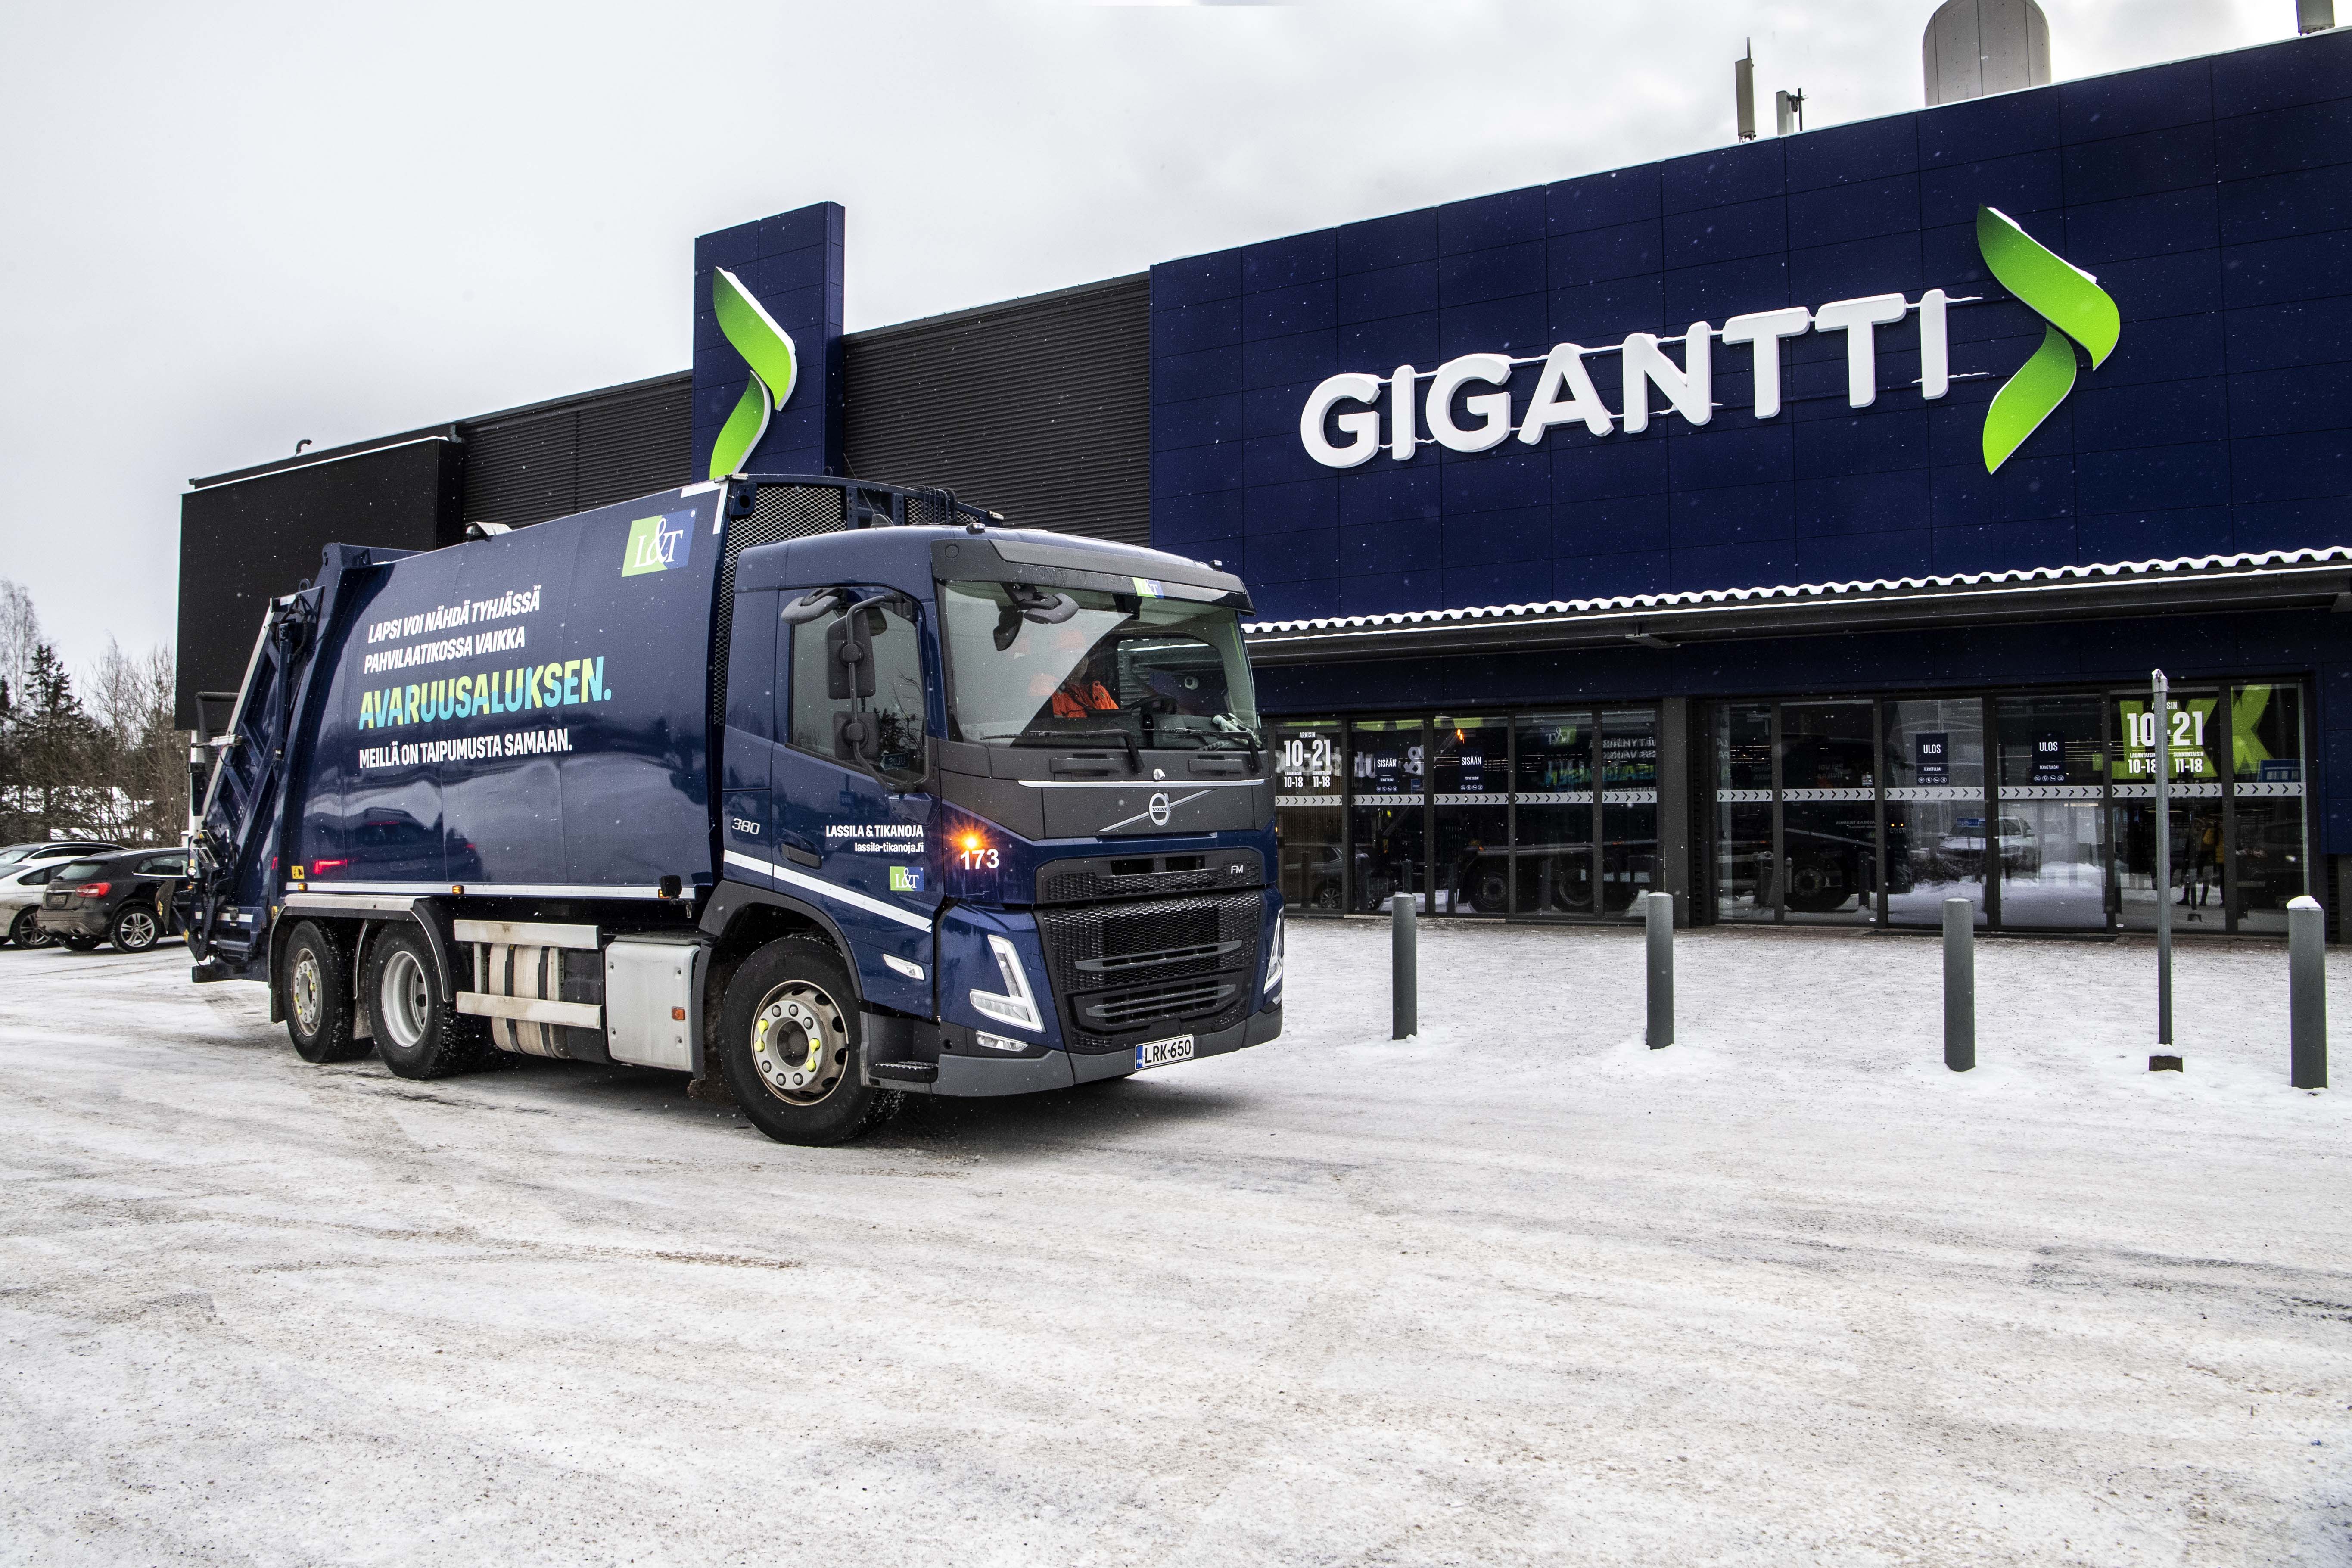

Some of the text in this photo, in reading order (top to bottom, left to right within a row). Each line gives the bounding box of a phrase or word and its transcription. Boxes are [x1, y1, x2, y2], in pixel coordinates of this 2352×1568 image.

[1300, 289, 1949, 468] GIGANTTI
[633, 518, 684, 568] L&T
[368, 585, 541, 644] LAPSI VOI NÄHDÄ TYHJÄSSÄ
[364, 626, 525, 674] PAHVILAATIKOSSA VAIKKA
[358, 656, 612, 730] AVARUUSALUKSEN.
[2152, 701, 2178, 710] ASIN
[2127, 711, 2203, 747] 1021
[359, 728, 572, 769] MEILLÄ ON TAIPUMUSTA SAMAAN.
[1284, 740, 1331, 766] 10-21
[1923, 744, 1941, 753] ULOS
[2039, 742, 2058, 751] ULOS
[1377, 758, 1397, 768] SISÄÄN
[1461, 756, 1481, 765] SISÄÄN
[2128, 759, 2156, 773] 10-18
[2175, 759, 2203, 772] 11-18
[1284, 776, 1303, 787] 10-18
[1313, 776, 1330, 787] 11-18
[732, 818, 760, 834] 380
[826, 825, 924, 837] LASSILA & TIKANOJA
[855, 842, 924, 854] lassila-tikanoja.fi
[960, 849, 999, 870] 173
[1231, 865, 1243, 874] FM
[896, 868, 919, 888] L&T
[1145, 1039, 1191, 1064] LRK-650
